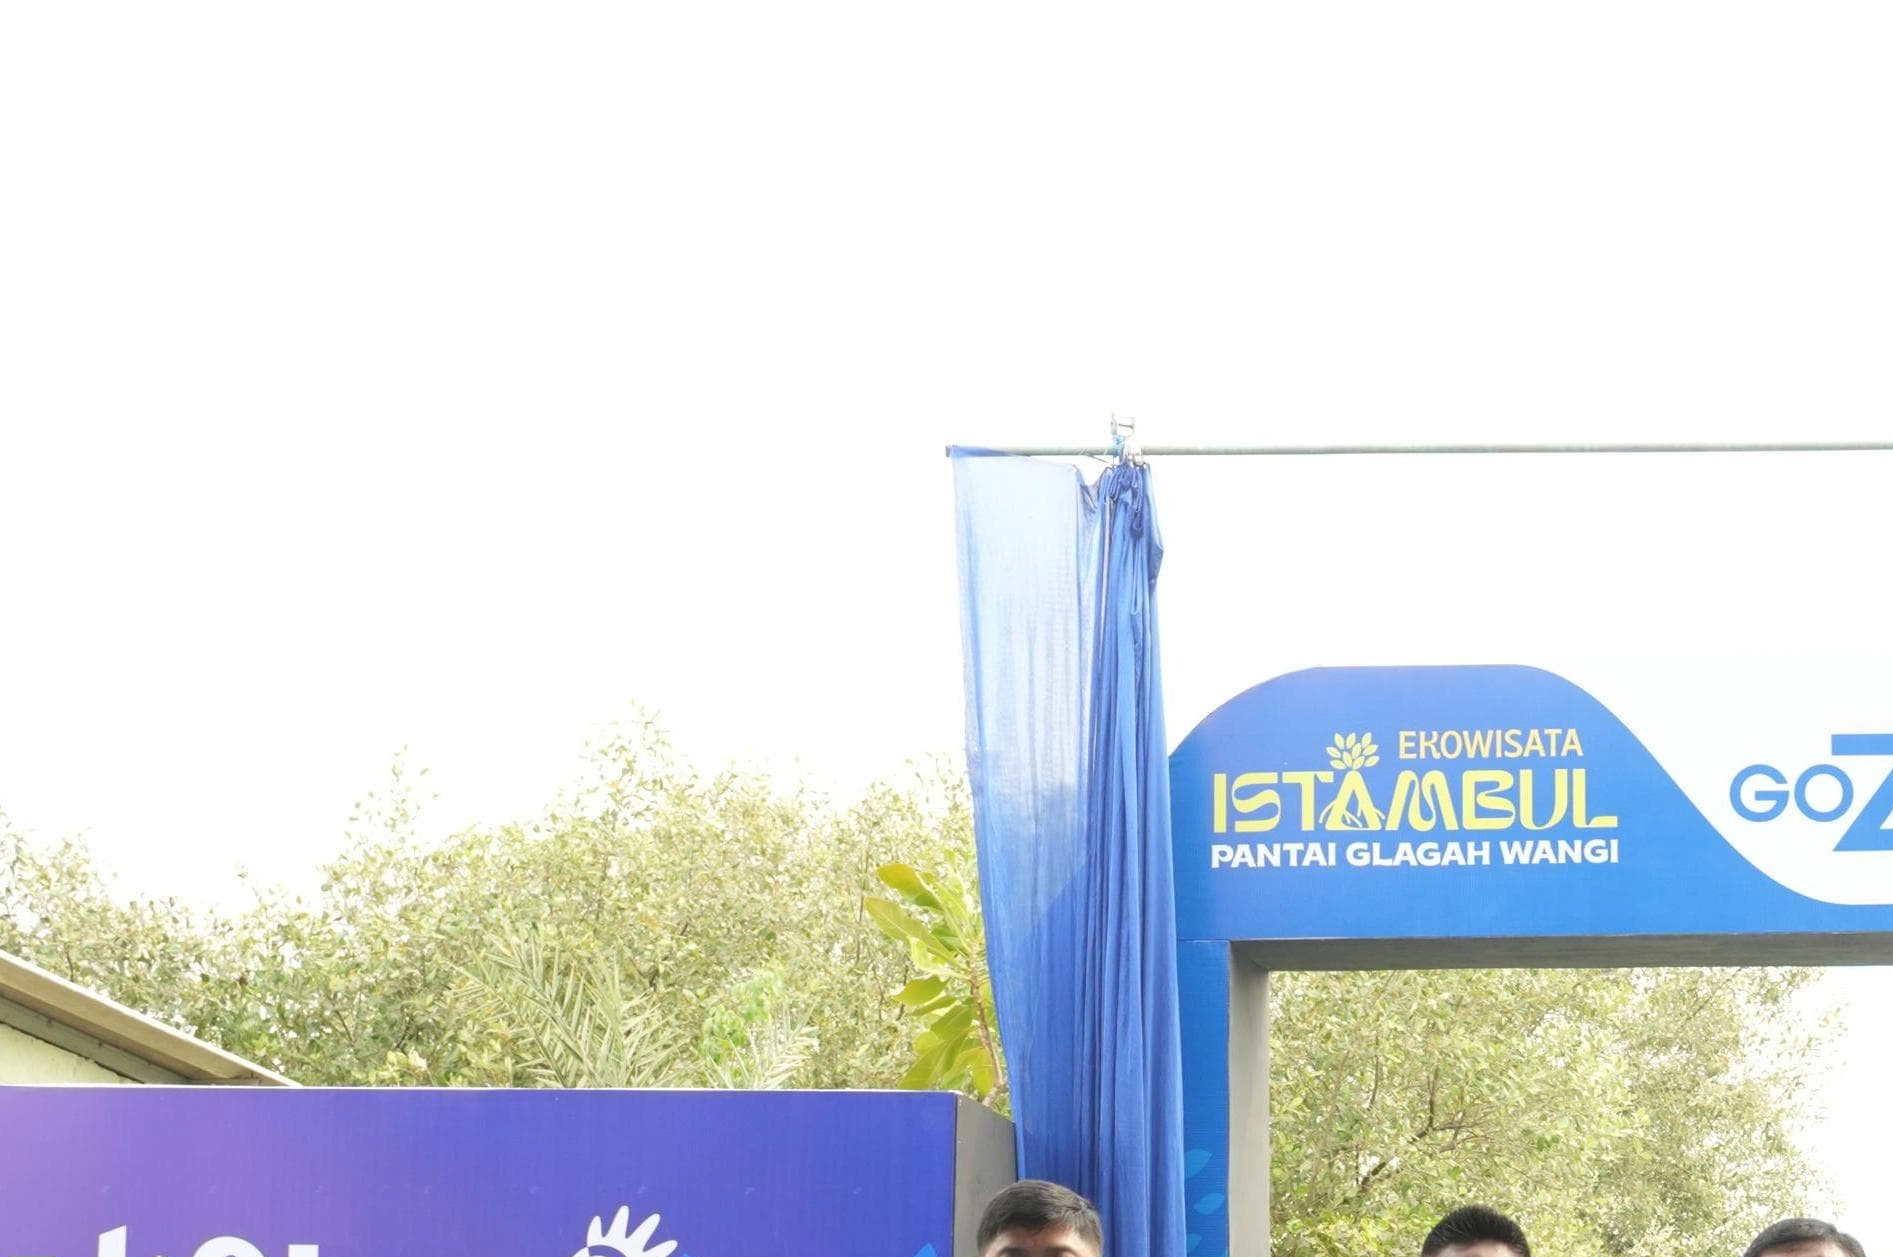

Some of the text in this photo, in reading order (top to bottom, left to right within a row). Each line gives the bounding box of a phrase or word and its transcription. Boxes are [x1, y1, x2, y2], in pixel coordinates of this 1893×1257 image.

[1399, 728, 1583, 759] EKOWISATA
[1212, 768, 1619, 833] ISTAMBUL
[1211, 839, 1619, 868] PANTAI GLAGAH WANGI
